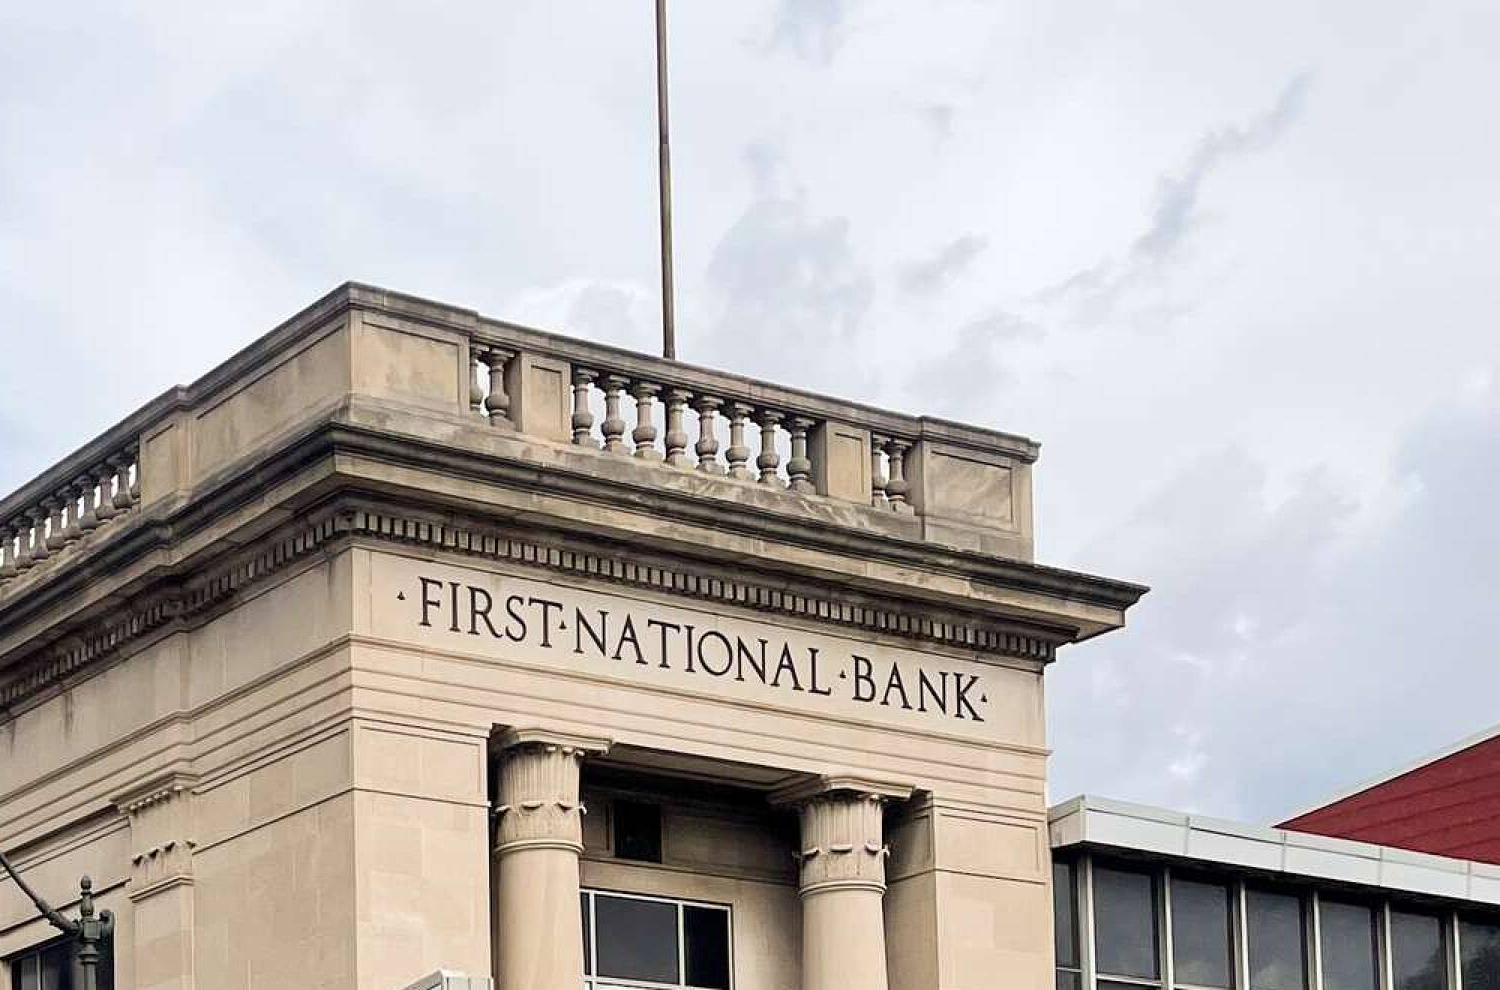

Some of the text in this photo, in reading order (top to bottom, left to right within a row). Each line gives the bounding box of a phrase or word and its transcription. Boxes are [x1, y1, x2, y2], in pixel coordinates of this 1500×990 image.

[418, 575, 985, 722] FIRST NATIONAL BANK
